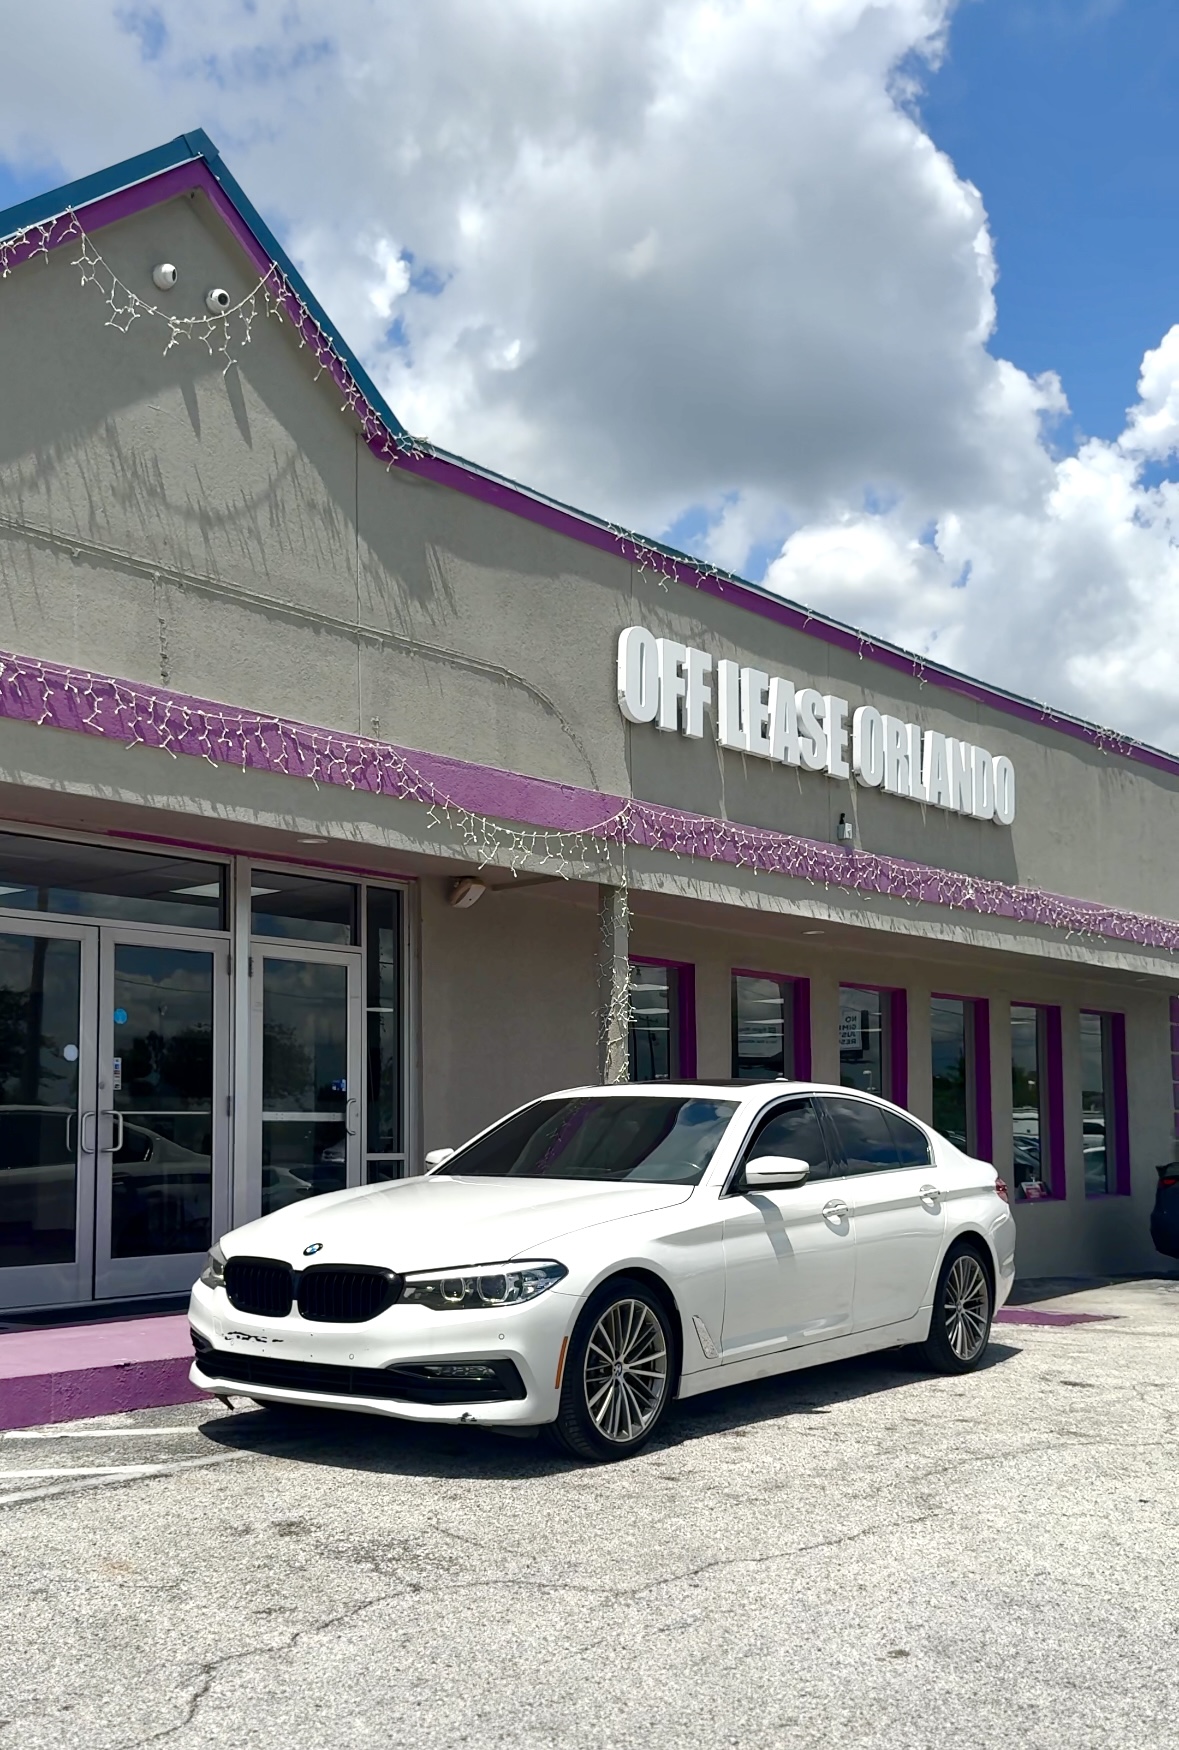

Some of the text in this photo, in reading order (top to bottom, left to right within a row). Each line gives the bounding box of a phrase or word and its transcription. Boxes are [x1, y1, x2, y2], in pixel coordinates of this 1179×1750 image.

[617, 626, 1016, 826] OFF LEASE ORLANDO
